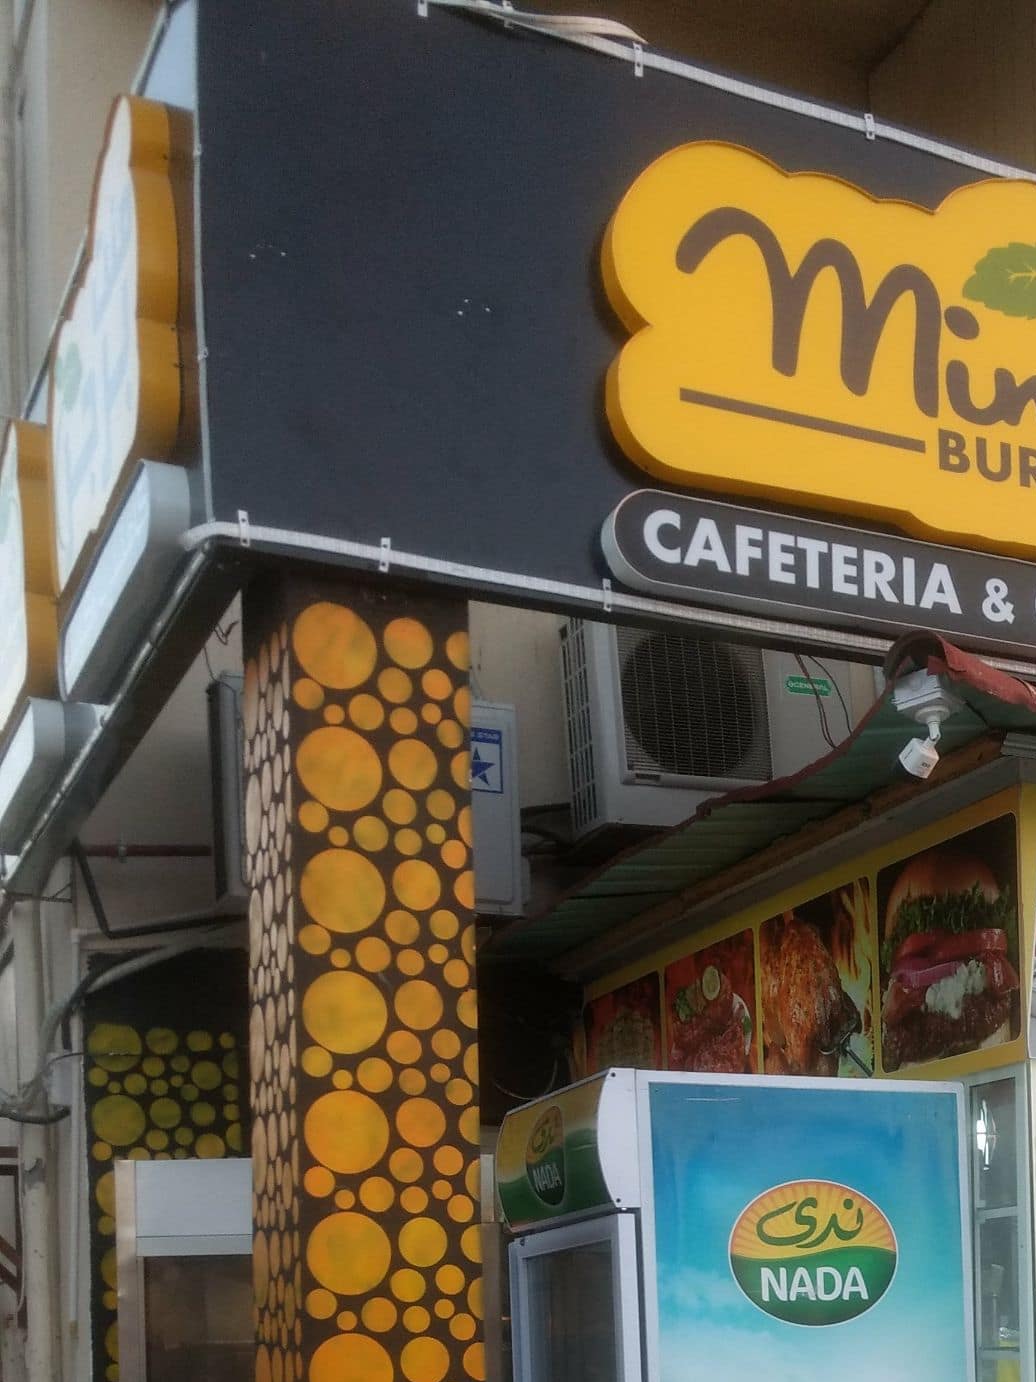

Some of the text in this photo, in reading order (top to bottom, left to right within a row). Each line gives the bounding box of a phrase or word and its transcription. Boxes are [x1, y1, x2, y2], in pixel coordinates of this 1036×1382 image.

[643, 508, 962, 616] CAFETERIA
[981, 578, 1016, 624] &
[760, 1266, 869, 1302] NADA
